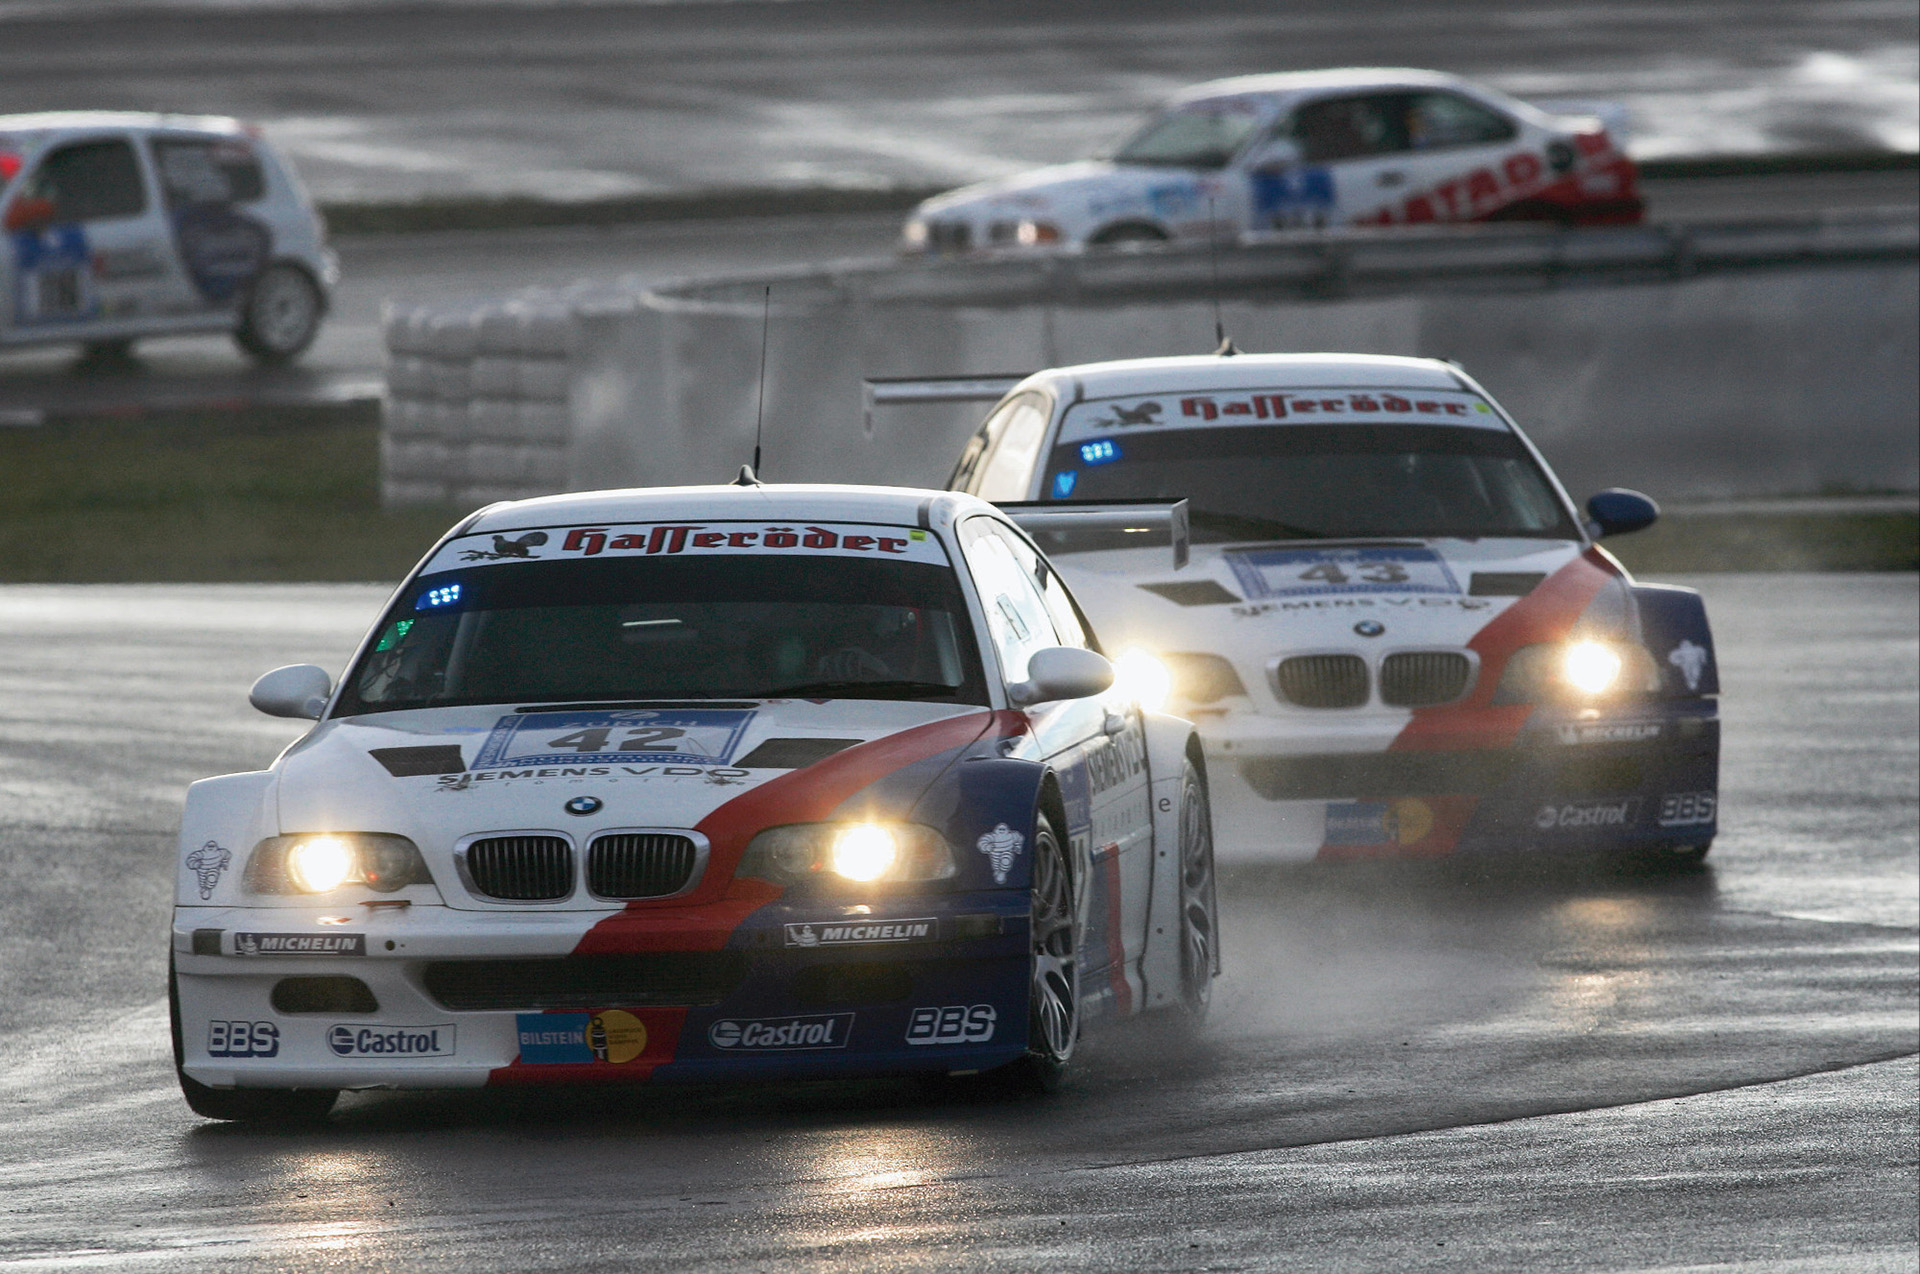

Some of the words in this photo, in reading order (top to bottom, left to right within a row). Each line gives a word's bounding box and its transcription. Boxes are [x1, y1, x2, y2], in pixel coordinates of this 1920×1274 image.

[1298, 562, 1410, 584] 43
[547, 727, 686, 752] 42
[437, 766, 611, 785] SIEMENS
[621, 766, 750, 779] VDO
[1559, 803, 1629, 826] Castrol
[260, 936, 358, 951] MICHELIN
[821, 923, 929, 941] MICHELIN
[742, 1018, 834, 1047] Castrol
[905, 1004, 997, 1046] BBS
[208, 1020, 280, 1058] BBS
[356, 1028, 440, 1054] Castrol
[520, 1031, 584, 1045] BILSTEIN
